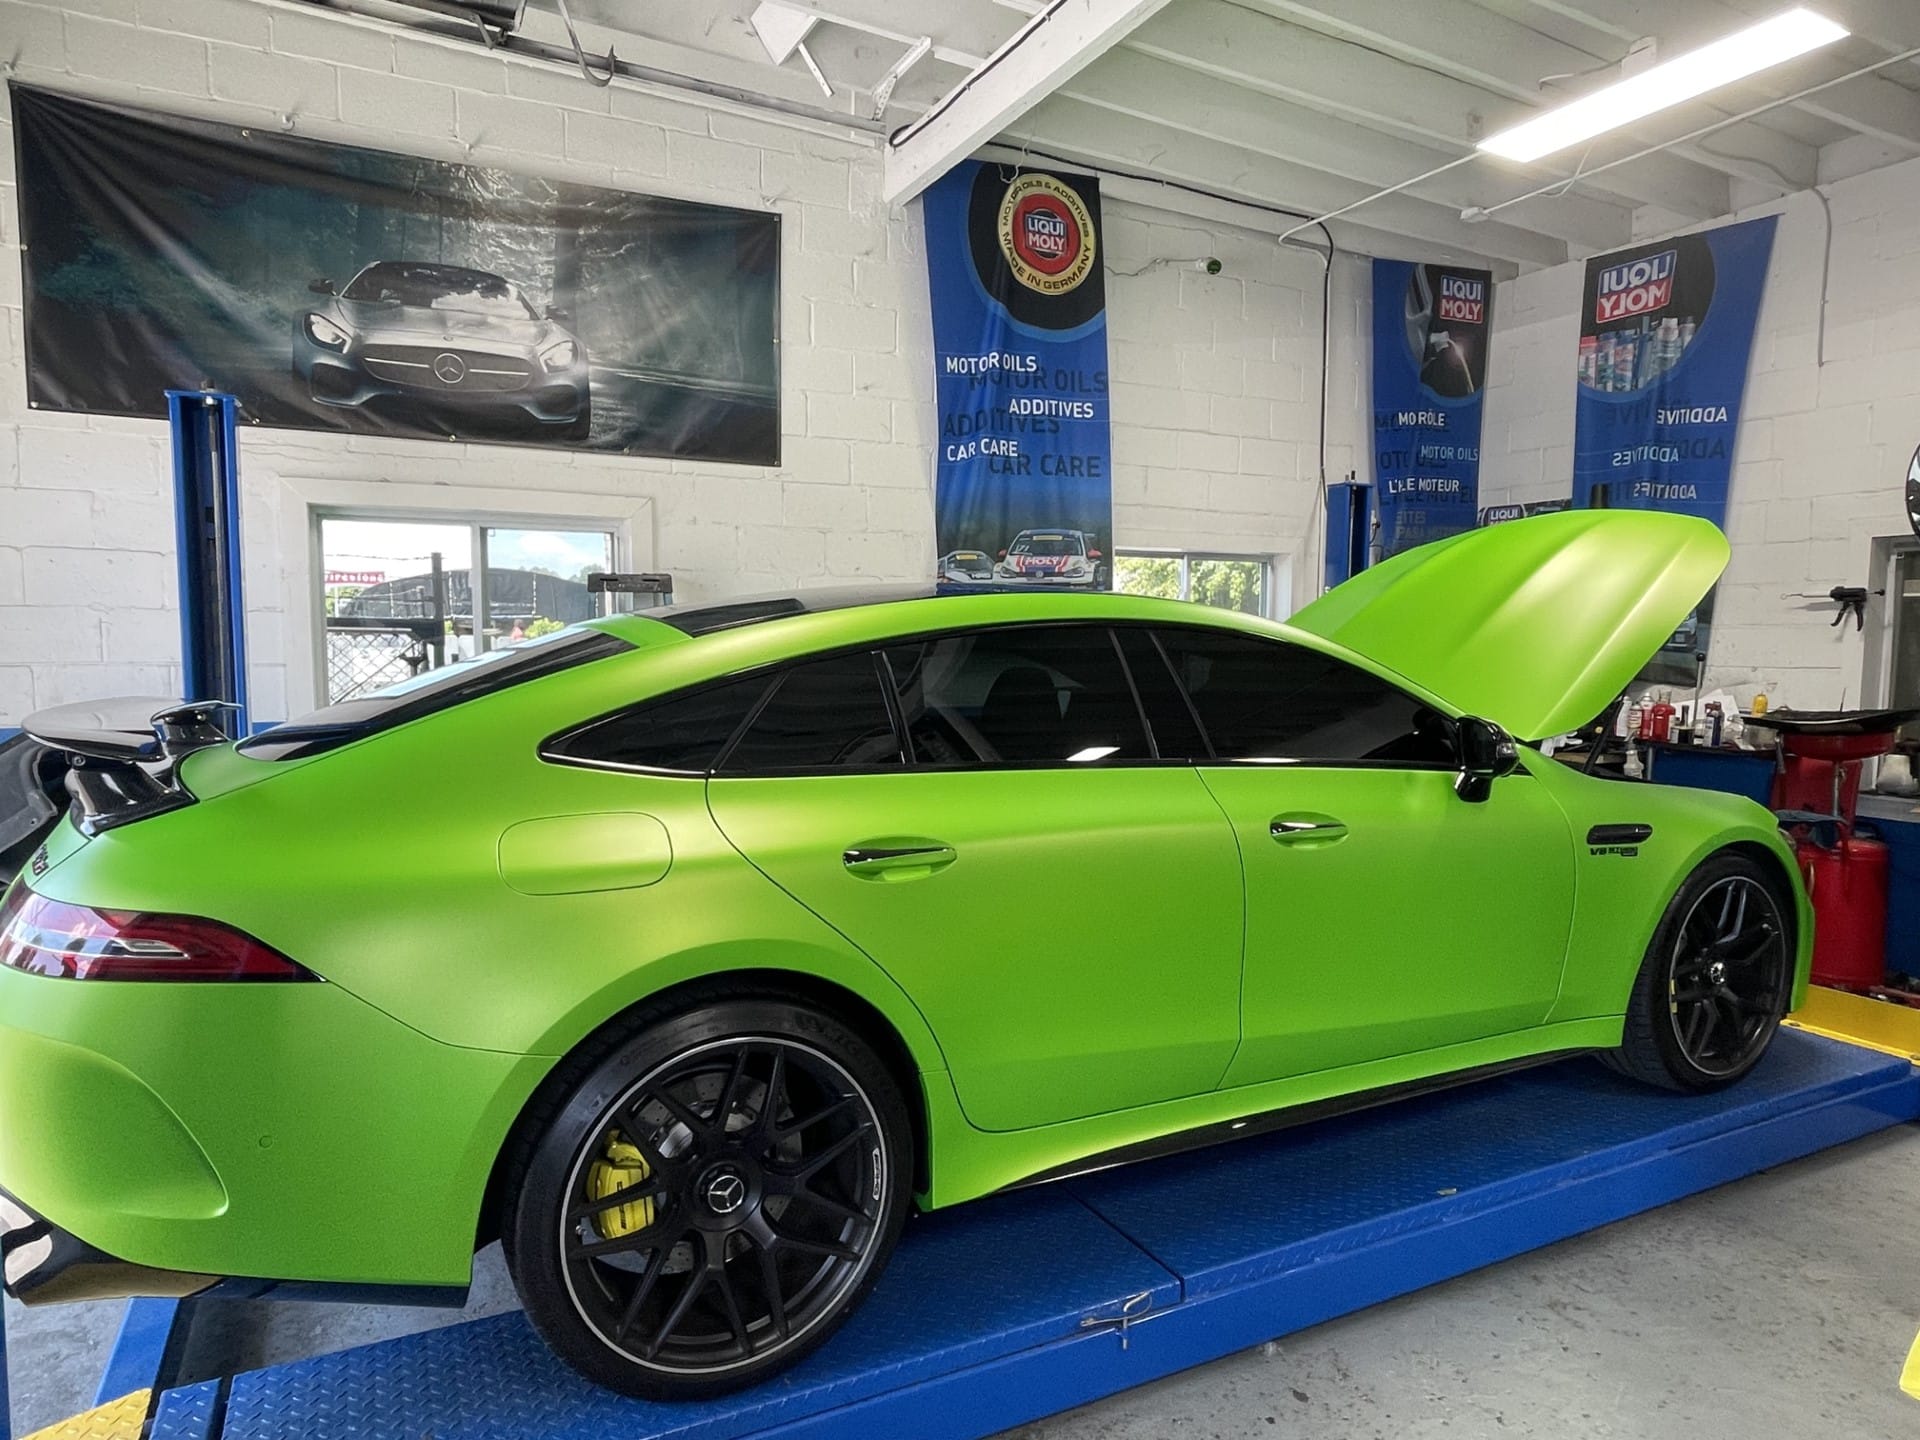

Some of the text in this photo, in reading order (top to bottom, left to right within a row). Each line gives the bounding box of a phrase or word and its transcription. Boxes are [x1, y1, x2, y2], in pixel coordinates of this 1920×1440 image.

[1003, 180, 1090, 238] MOTOR OILS & ADDITIVES
[1028, 217, 1064, 236] LIQUI
[1028, 233, 1065, 251] MOLY
[1003, 231, 1092, 289] MADE IN GERMANY
[1442, 278, 1482, 300] LIQUI
[1441, 299, 1482, 320] MOLY
[946, 352, 1037, 374] MOTOR OILS
[1009, 399, 1094, 418] ADDITIVES
[947, 438, 1018, 461] CAR CARE
[1420, 445, 1454, 460] MOTOR
[1457, 447, 1479, 461] OILS
[1491, 508, 1518, 520] LIQUI
